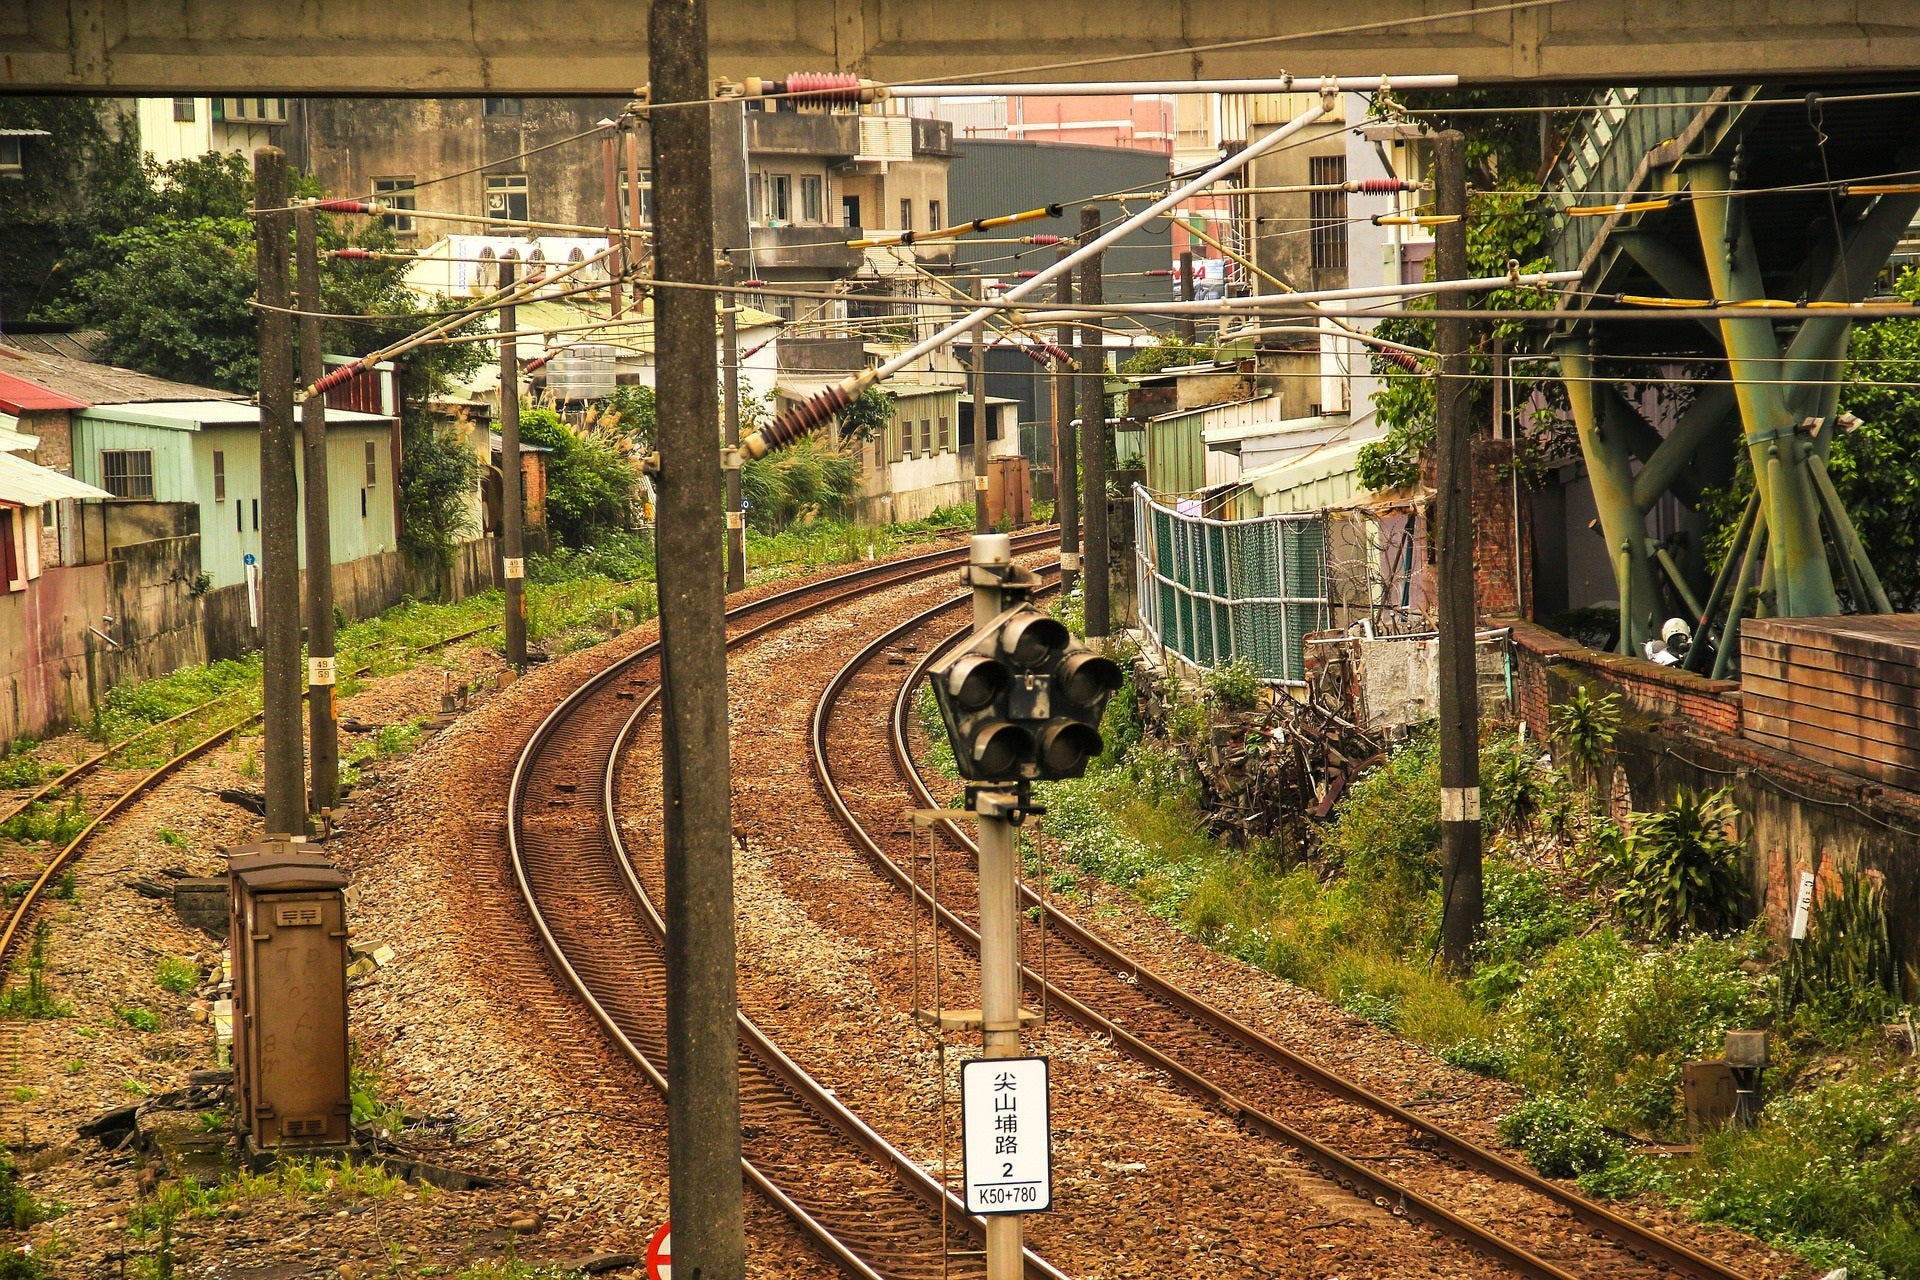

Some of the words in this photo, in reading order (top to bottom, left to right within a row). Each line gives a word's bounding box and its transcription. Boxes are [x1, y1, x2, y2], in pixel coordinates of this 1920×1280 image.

[994, 1072, 1018, 1155] 尖山埔路
[1002, 1163, 1013, 1177] 2
[980, 1187, 1036, 1205] K50+780
